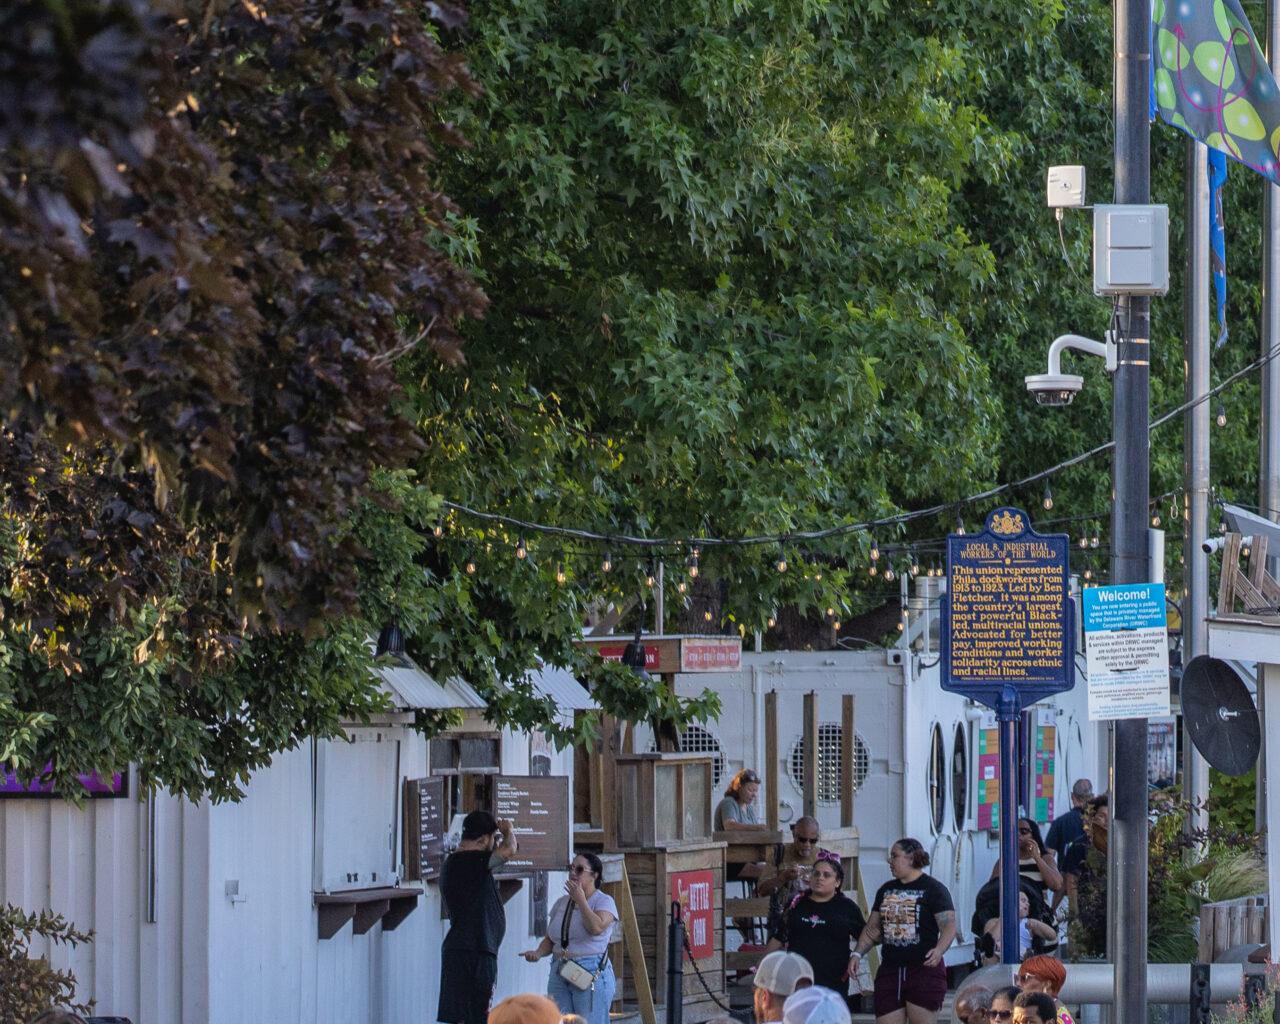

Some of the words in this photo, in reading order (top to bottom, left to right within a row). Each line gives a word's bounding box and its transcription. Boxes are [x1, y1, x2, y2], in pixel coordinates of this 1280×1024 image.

[960, 551, 995, 559] WORKERS
[952, 566, 973, 574] This
[976, 566, 1003, 574] union
[1005, 566, 1063, 576] represented
[980, 575, 1038, 583] dockworkers
[952, 584, 970, 592] 1913
[1029, 584, 1042, 594] by
[1031, 595, 1063, 604] among
[1098, 588, 1150, 602] Welcome!
[973, 604, 1022, 613] country's
[980, 611, 1025, 622] powerful
[1030, 612, 1062, 620] Black-
[973, 621, 1025, 629] multiracial
[975, 640, 1020, 649] improved
[1023, 640, 1063, 649] working
[952, 648, 1002, 657] conditions
[952, 658, 1000, 668] solidarity
[1032, 658, 1063, 667] ethnic
[952, 667, 971, 676] and
[974, 667, 1000, 675] racial
